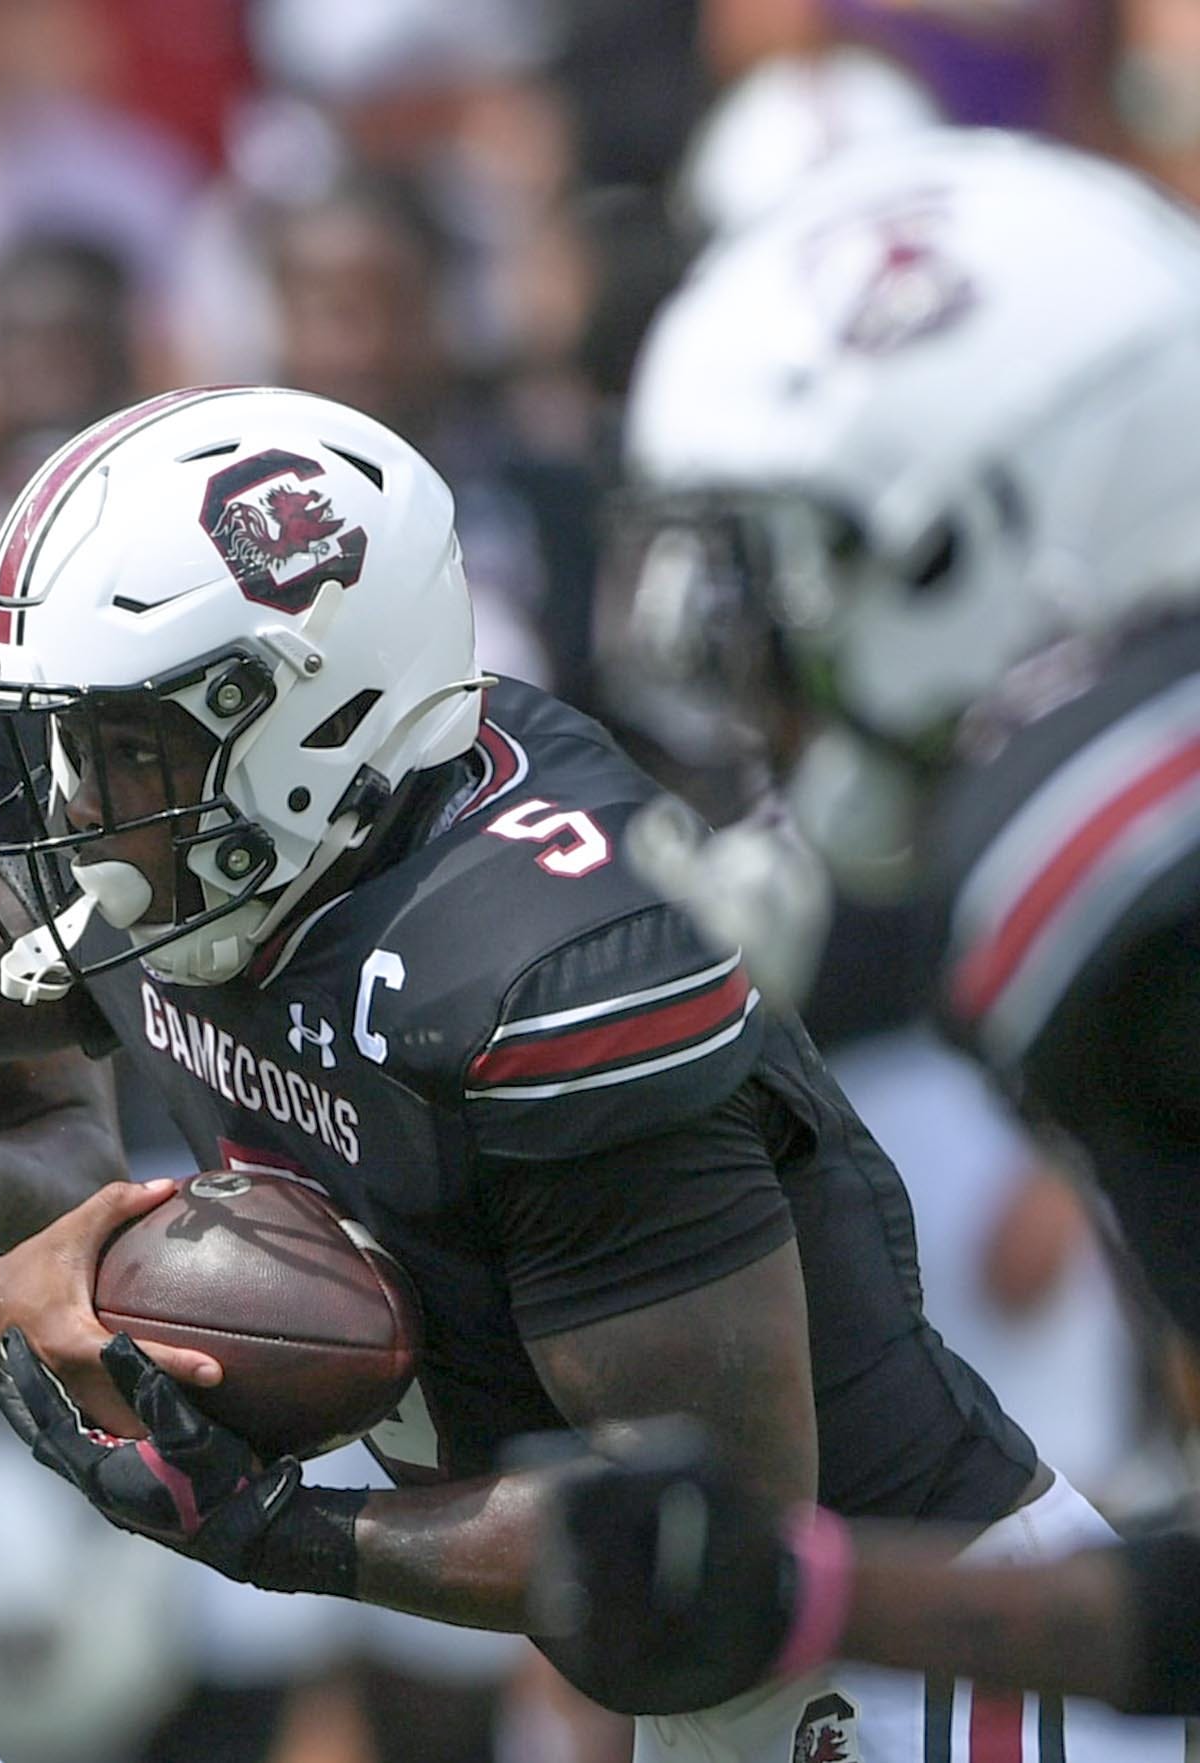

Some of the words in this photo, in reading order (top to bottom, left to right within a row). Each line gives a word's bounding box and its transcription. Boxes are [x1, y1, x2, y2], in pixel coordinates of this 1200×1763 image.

[481, 798, 613, 877] 5
[353, 948, 406, 1065] C
[140, 980, 360, 1166] GAMECOCKS
